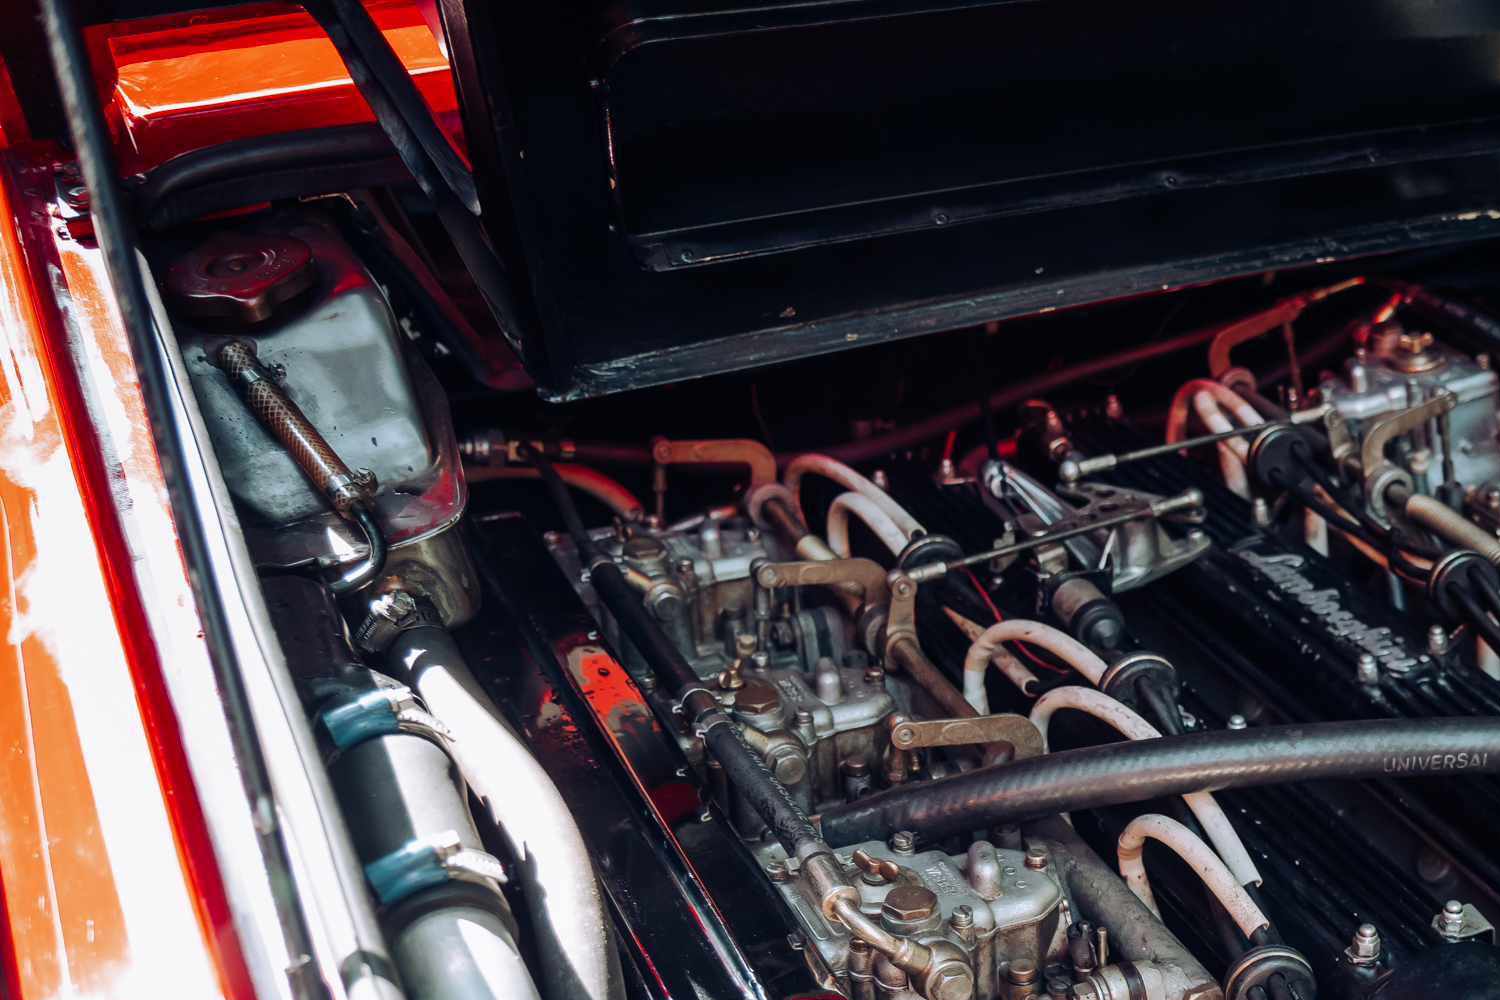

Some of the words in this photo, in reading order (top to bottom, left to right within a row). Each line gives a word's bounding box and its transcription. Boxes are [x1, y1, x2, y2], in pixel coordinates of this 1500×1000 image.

[1238, 551, 1431, 678] Lamborghini
[769, 776, 809, 822] GASOLINE
[804, 824, 824, 844] HOS
